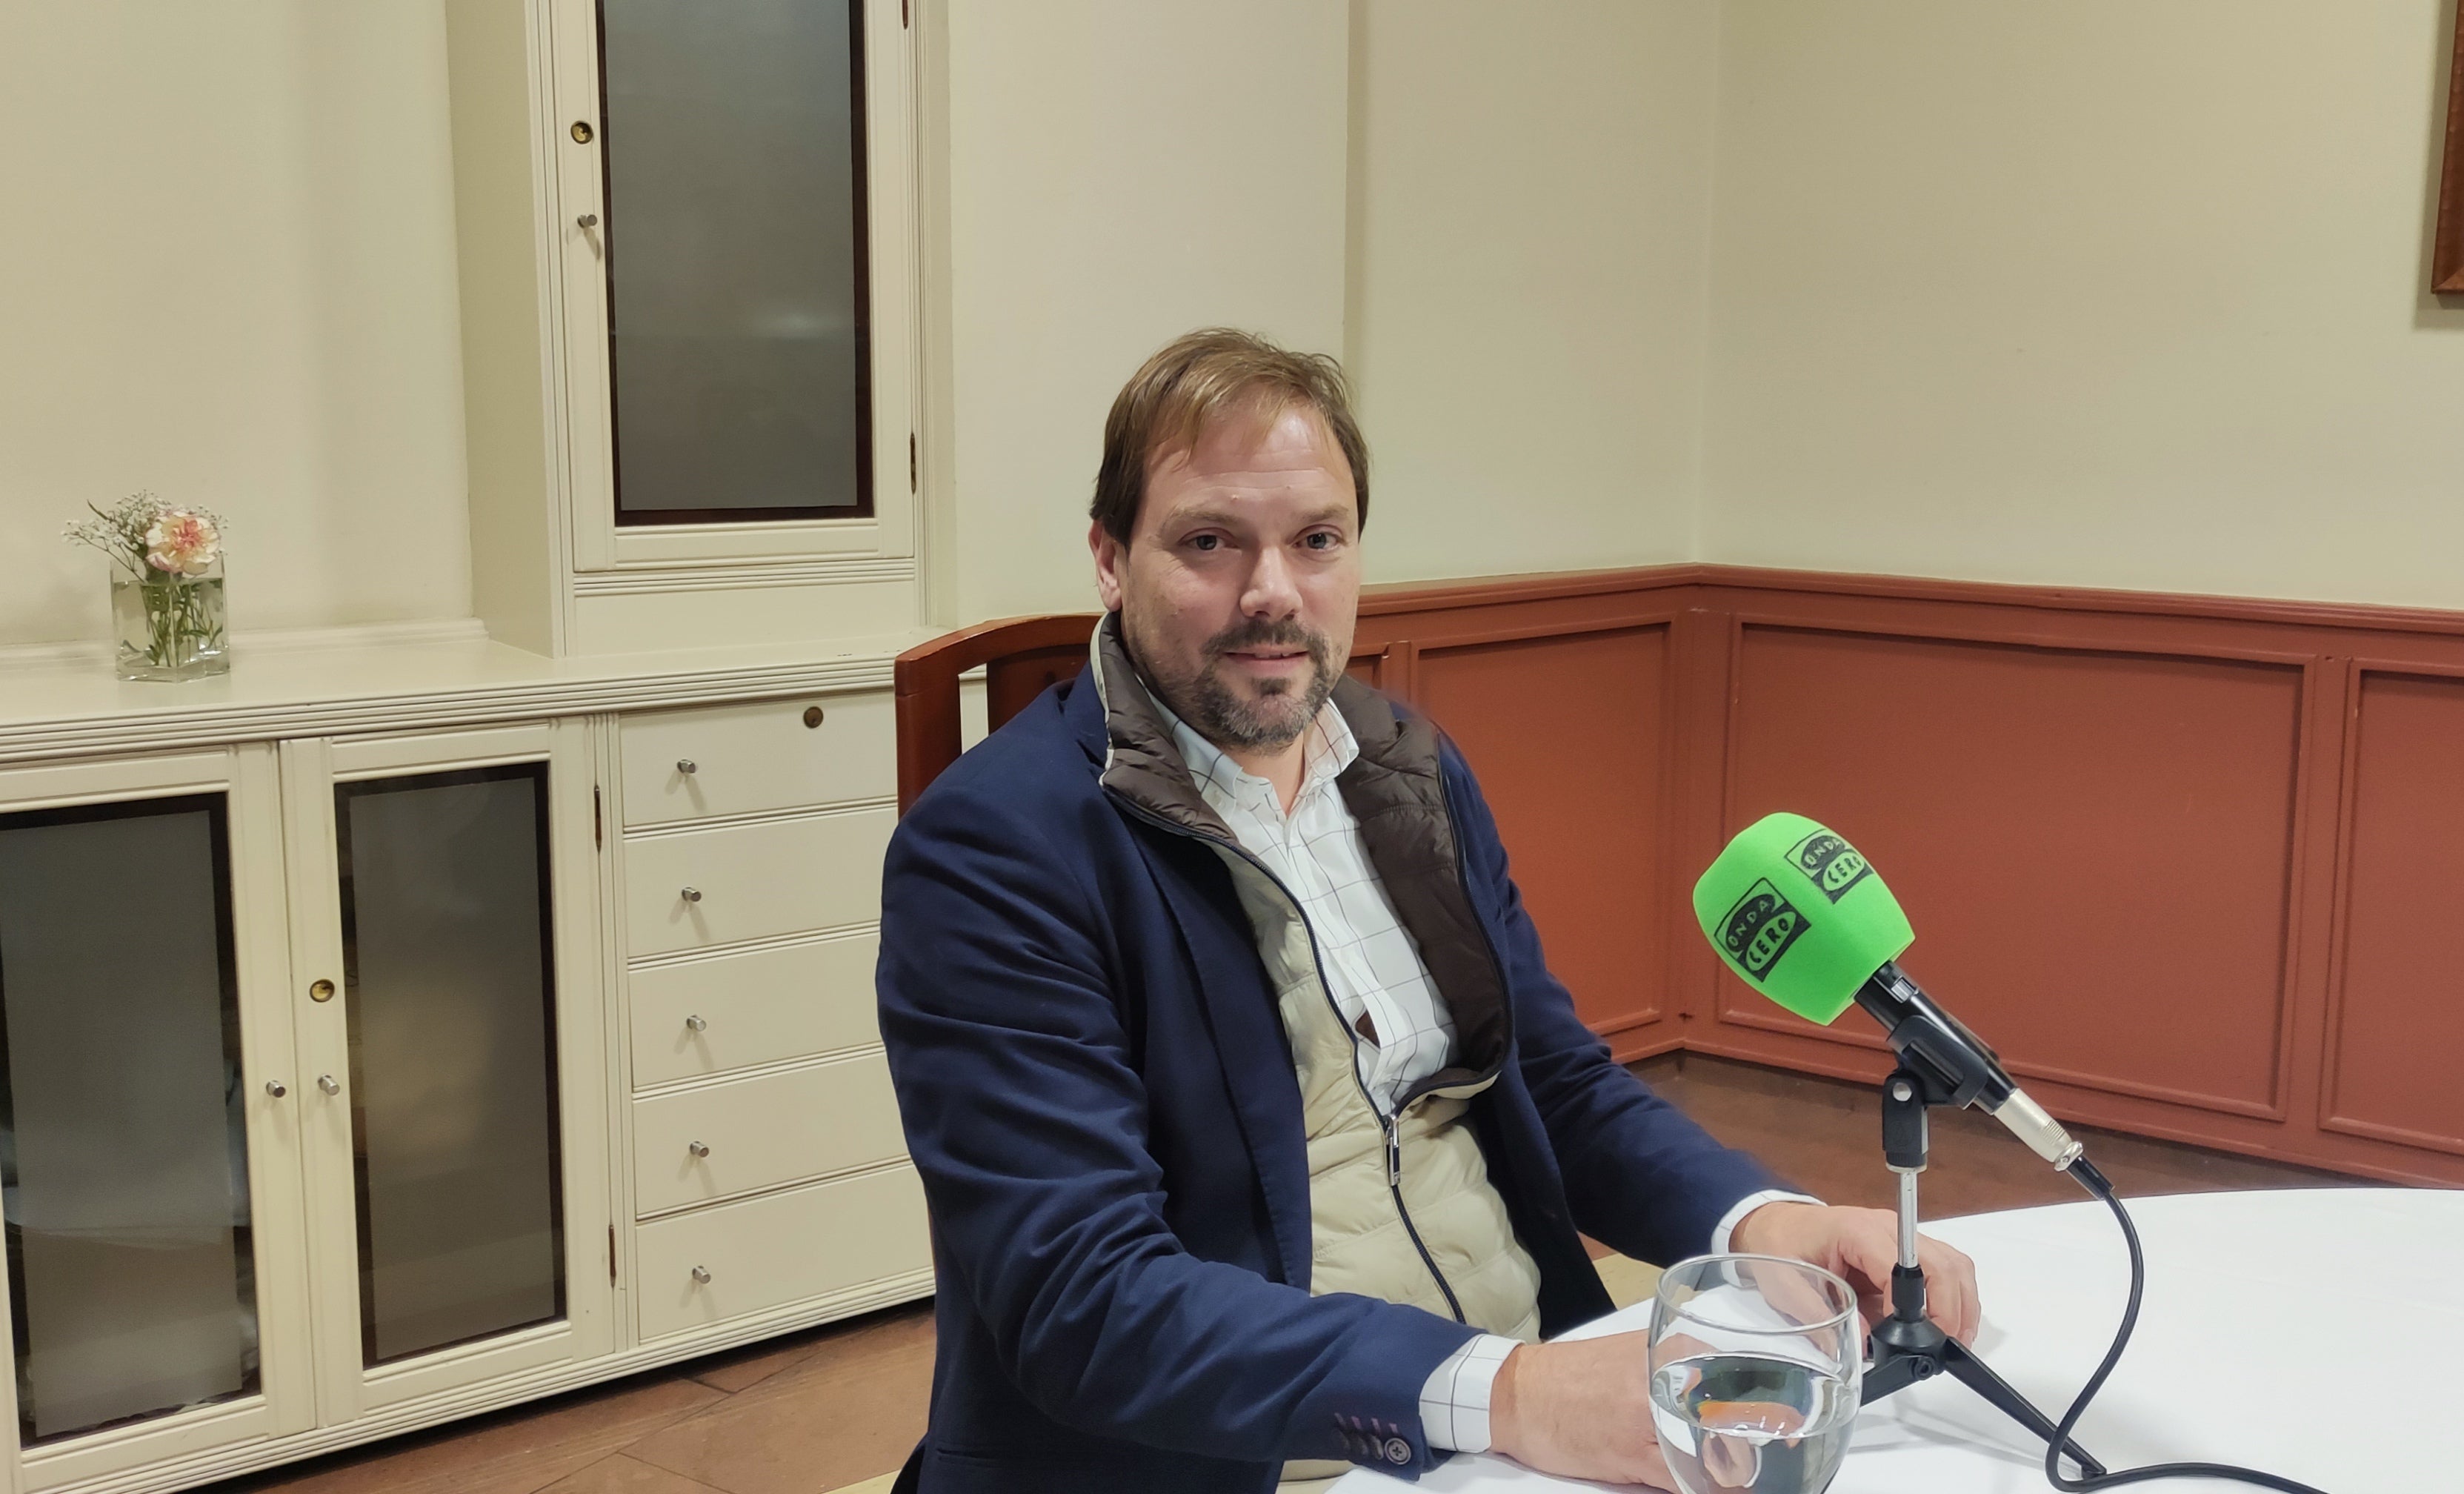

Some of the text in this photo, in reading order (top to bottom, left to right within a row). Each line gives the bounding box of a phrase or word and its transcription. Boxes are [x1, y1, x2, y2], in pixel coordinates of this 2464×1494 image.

[1805, 839, 1842, 865] ONDA
[1828, 855, 1862, 883] CERO
[1728, 900, 1769, 946] ONDA
[1749, 918, 1789, 963] CERO
